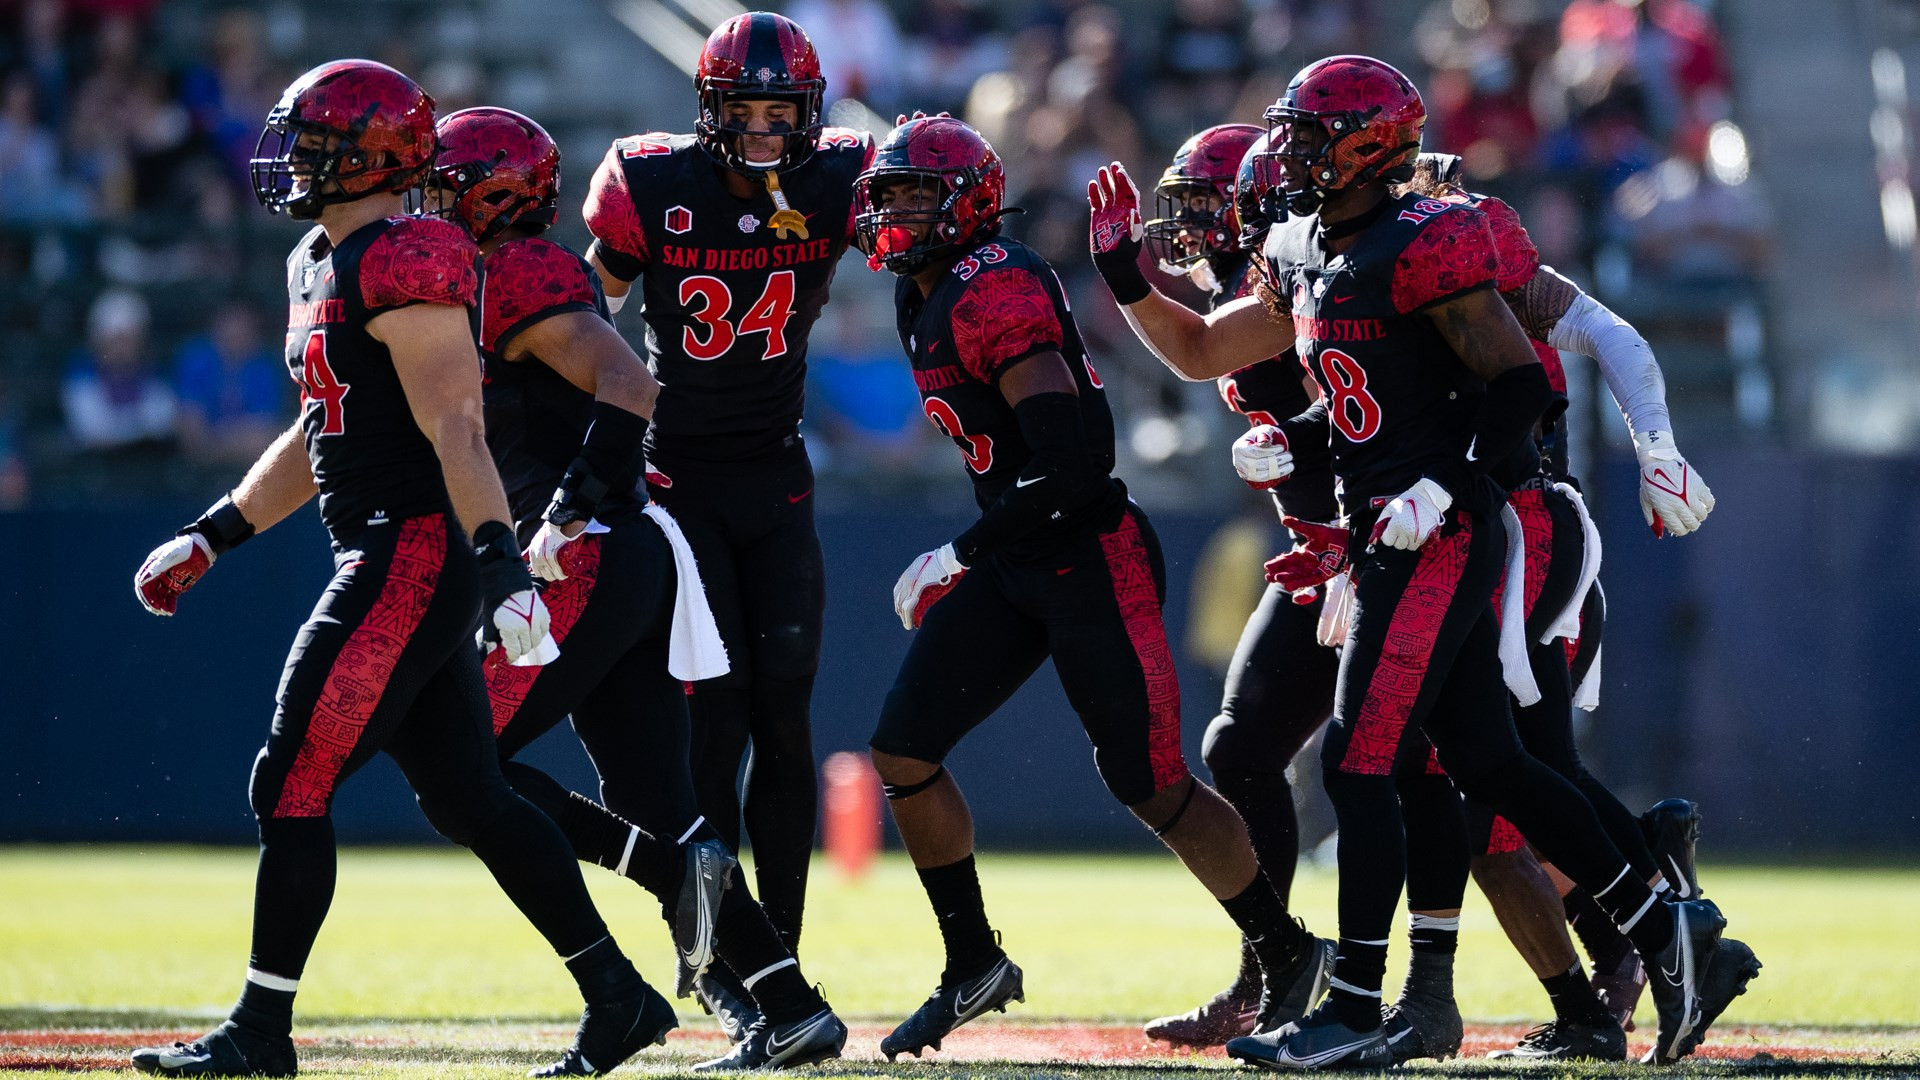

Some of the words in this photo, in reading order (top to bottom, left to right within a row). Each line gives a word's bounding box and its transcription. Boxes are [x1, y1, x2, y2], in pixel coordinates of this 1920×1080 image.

[1397, 199, 1452, 226] 18
[662, 245, 699, 269] SAN
[704, 247, 768, 271] DIEGO
[772, 238, 831, 268] STATE
[952, 243, 1008, 280] 33
[679, 270, 796, 360] 34
[1332, 319, 1386, 341] STATE
[926, 365, 965, 390] STATE
